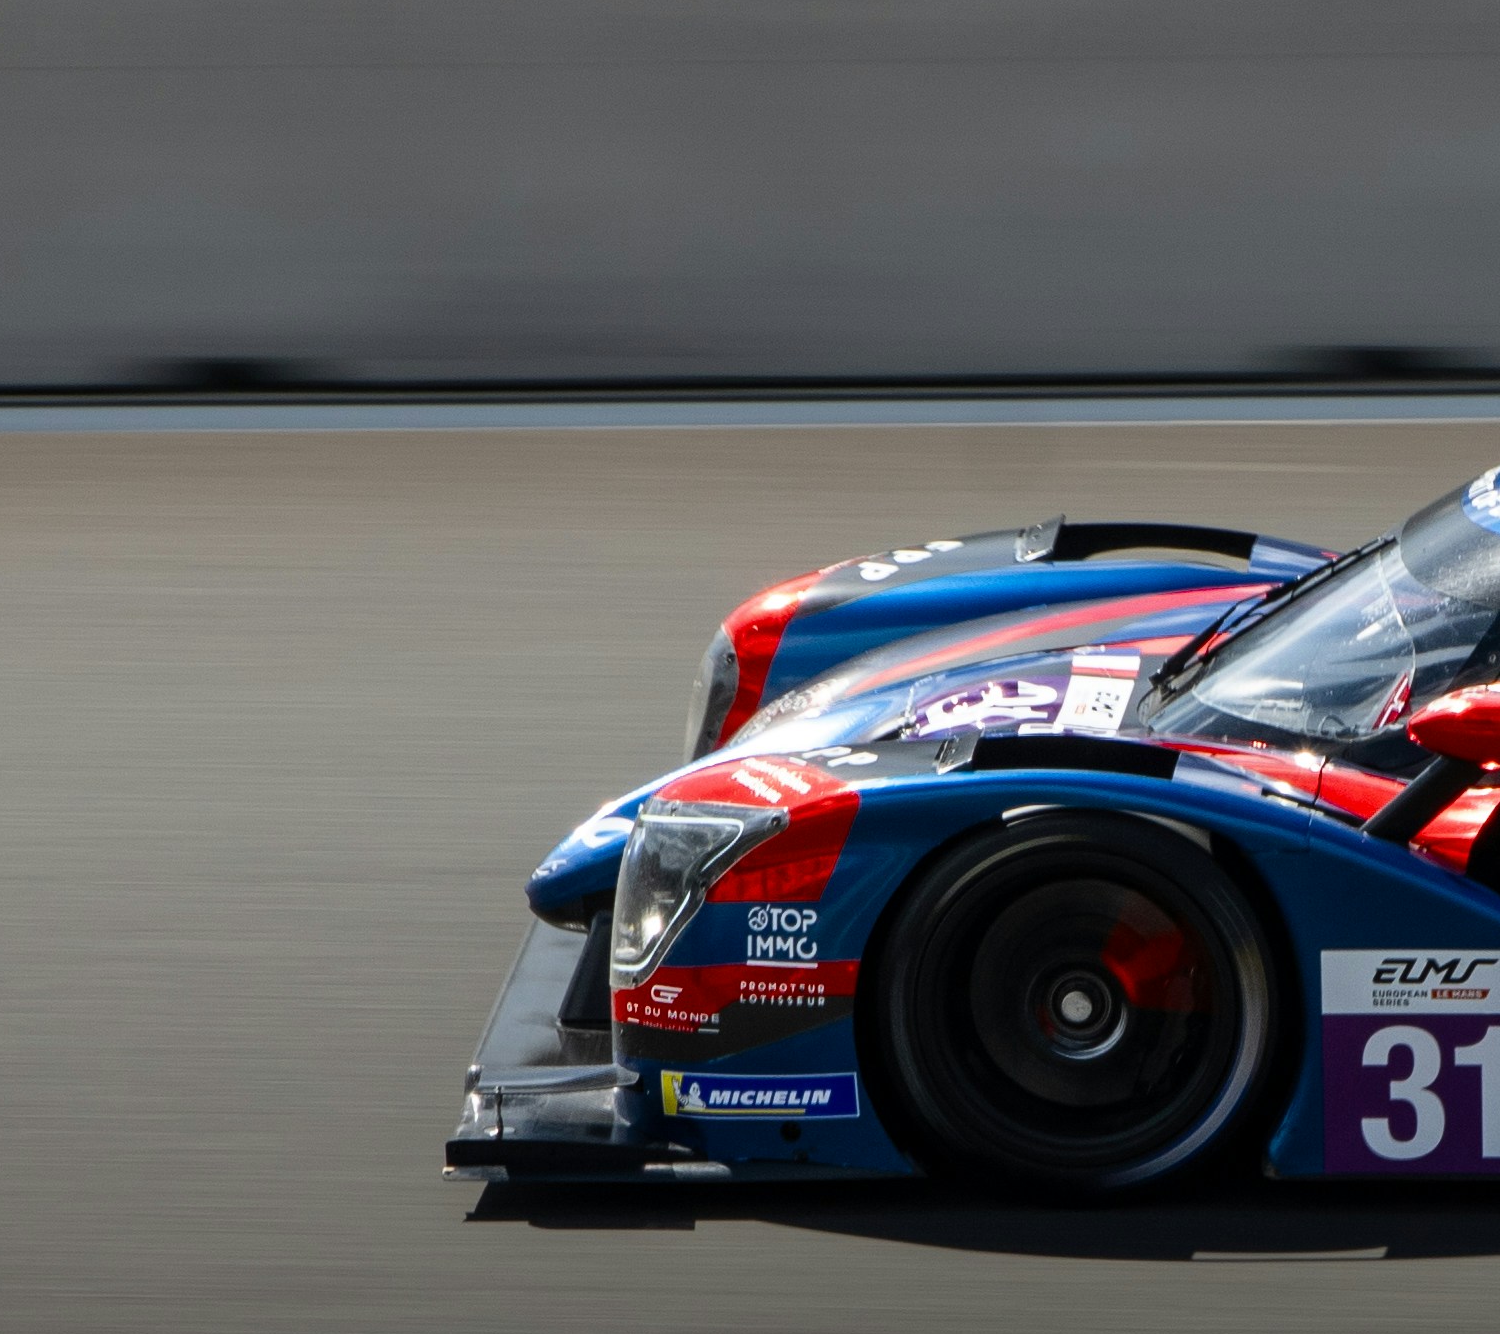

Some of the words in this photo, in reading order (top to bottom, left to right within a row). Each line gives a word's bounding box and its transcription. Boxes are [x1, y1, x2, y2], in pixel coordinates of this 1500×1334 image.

[747, 935, 817, 960] IMMO
[739, 980, 825, 994] PROMOTEUR
[1372, 989, 1428, 998] EUROPEAN
[1436, 989, 1449, 999] LE
[1451, 989, 1483, 999] MANS
[739, 994, 825, 1007] LOTISSEUR
[1372, 998, 1410, 1007] SERIES
[626, 1002, 639, 1014] GT
[644, 1005, 661, 1018] DU
[667, 1010, 720, 1025] MONDE
[708, 1088, 832, 1106] MICHELIN
